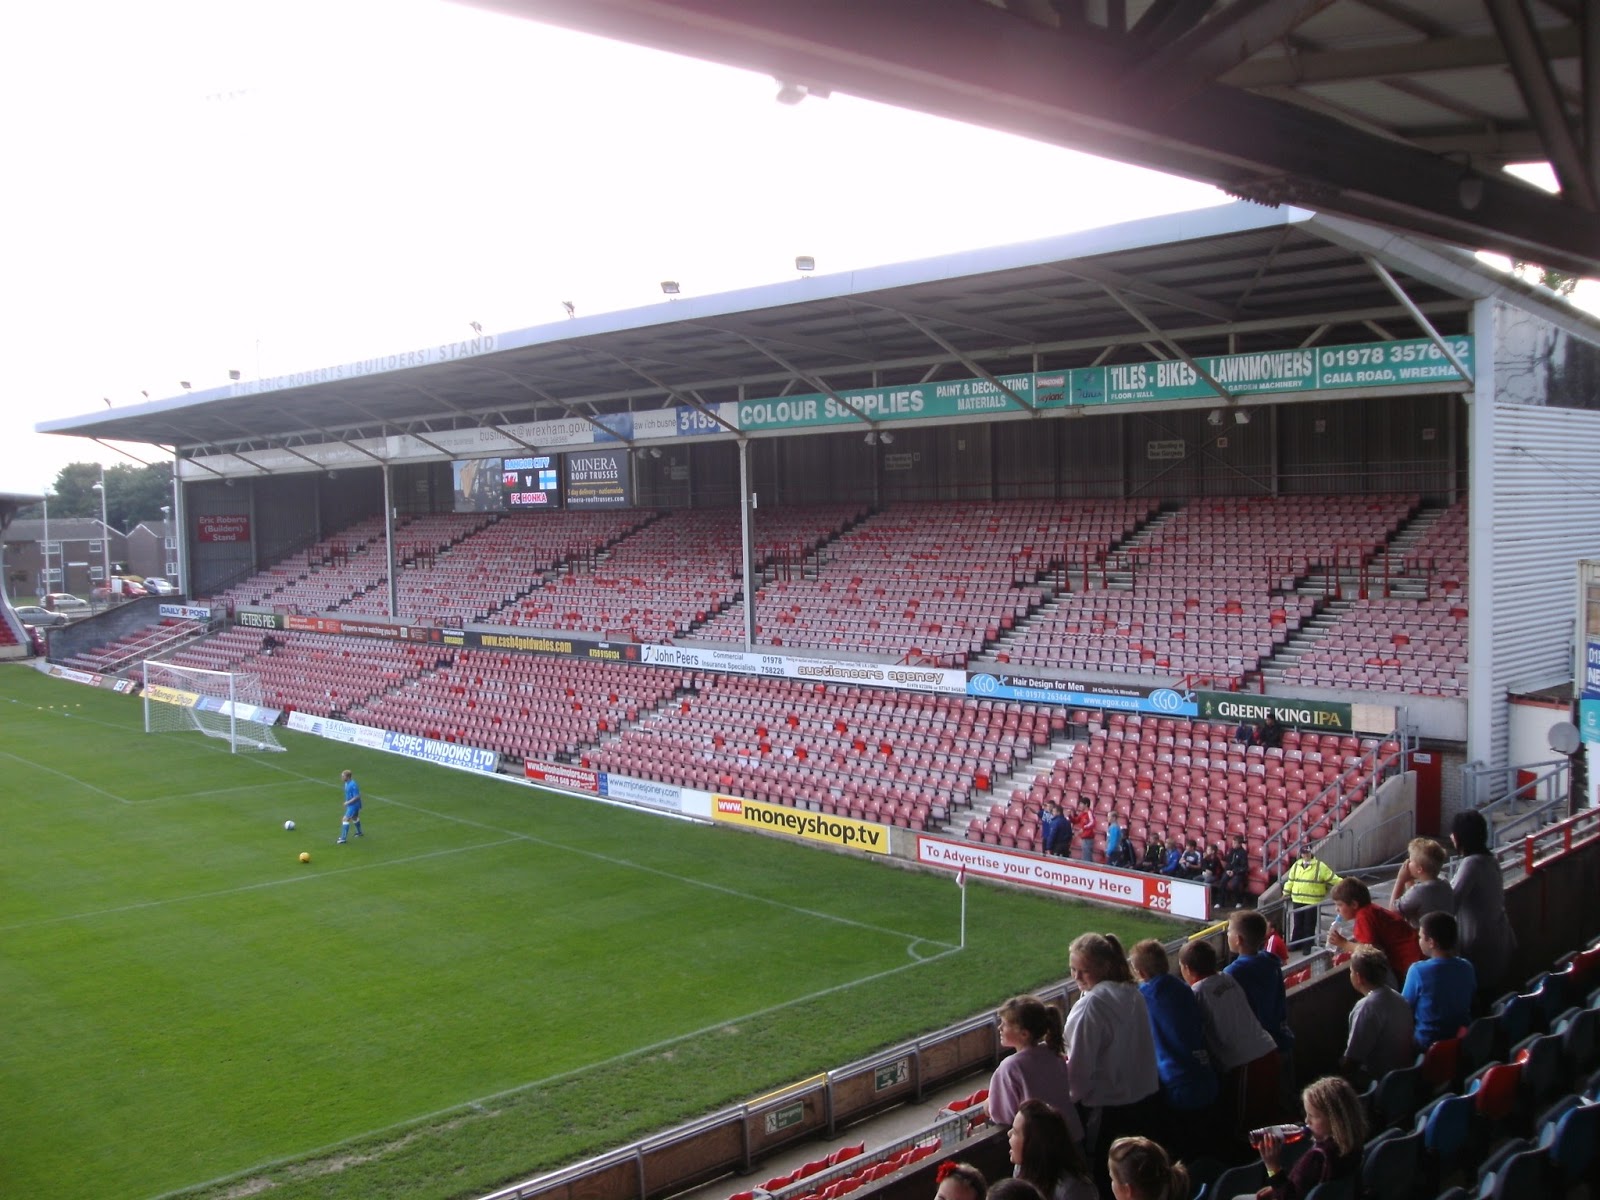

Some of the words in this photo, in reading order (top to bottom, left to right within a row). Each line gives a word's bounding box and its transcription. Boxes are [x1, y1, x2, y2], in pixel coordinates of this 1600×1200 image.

[1322, 347, 1384, 367] 01978
[1390, 341, 1469, 363] 35762
[259, 376, 283, 391] ERIC
[288, 365, 343, 387] ROBERTS
[349, 348, 431, 375] (BUILDERS)
[439, 335, 494, 360] STAND
[1110, 365, 1146, 391] TILES
[1157, 361, 1197, 388] BIKES
[1210, 351, 1312, 383] LAWNMOWERS
[1323, 372, 1353, 384] CAIA
[1357, 369, 1396, 382] ROAD,
[936, 384, 961, 397] PAINT
[972, 378, 1029, 394] DECOATING
[1229, 383, 1257, 392] GARDEN
[1259, 380, 1302, 389] MACHINERY
[958, 395, 1006, 410] MATERIALS
[1111, 392, 1132, 400] FLOOR
[741, 400, 817, 425] COLOUR
[824, 390, 924, 418] SUPPLIES
[505, 459, 532, 470] BANGOR
[534, 457, 549, 468] CITY
[571, 457, 617, 471] MINERA
[571, 472, 587, 480] ROOF
[590, 471, 618, 479] TRUSSES
[511, 493, 520, 504] FC
[522, 492, 547, 503] HONKA
[568, 495, 624, 504] minera-rooftrusses.com
[217, 515, 247, 523] Roberts
[205, 525, 243, 534] (Builders)
[213, 533, 236, 541] Stand
[161, 606, 180, 615] DAILY
[189, 609, 208, 617] POST
[263, 614, 275, 628] PIES
[481, 635, 572, 653] www.cash4goldwales.com
[655, 649, 674, 662] John
[676, 650, 698, 665] Peers
[713, 651, 743, 660] Commercial
[763, 655, 782, 664] 01978
[702, 660, 726, 669] Insurance
[727, 662, 756, 672] Specialists
[798, 665, 884, 680] auctioneers
[888, 671, 944, 685] agency
[973, 676, 995, 694] EGO
[1012, 677, 1027, 686] Hair
[1028, 679, 1053, 690] Design
[1055, 681, 1066, 689] for
[1067, 682, 1084, 691] Men
[1025, 690, 1046, 700] 01978
[1084, 697, 1139, 708] www.egox.co.uk
[1152, 690, 1177, 710] EGO
[1218, 701, 1271, 720] GREENE
[1274, 707, 1310, 724] KING
[1313, 710, 1342, 727] IPA
[392, 733, 422, 751] ASPEC
[424, 739, 472, 762] WINDOWS
[474, 750, 494, 766] LTD
[719, 801, 741, 811] www.
[744, 806, 880, 845] moneyshop.tv
[926, 845, 939, 857] To
[943, 849, 1000, 869] Advertise
[1003, 861, 1031, 875] your
[1034, 866, 1095, 890] Company
[1099, 877, 1132, 895] Here
